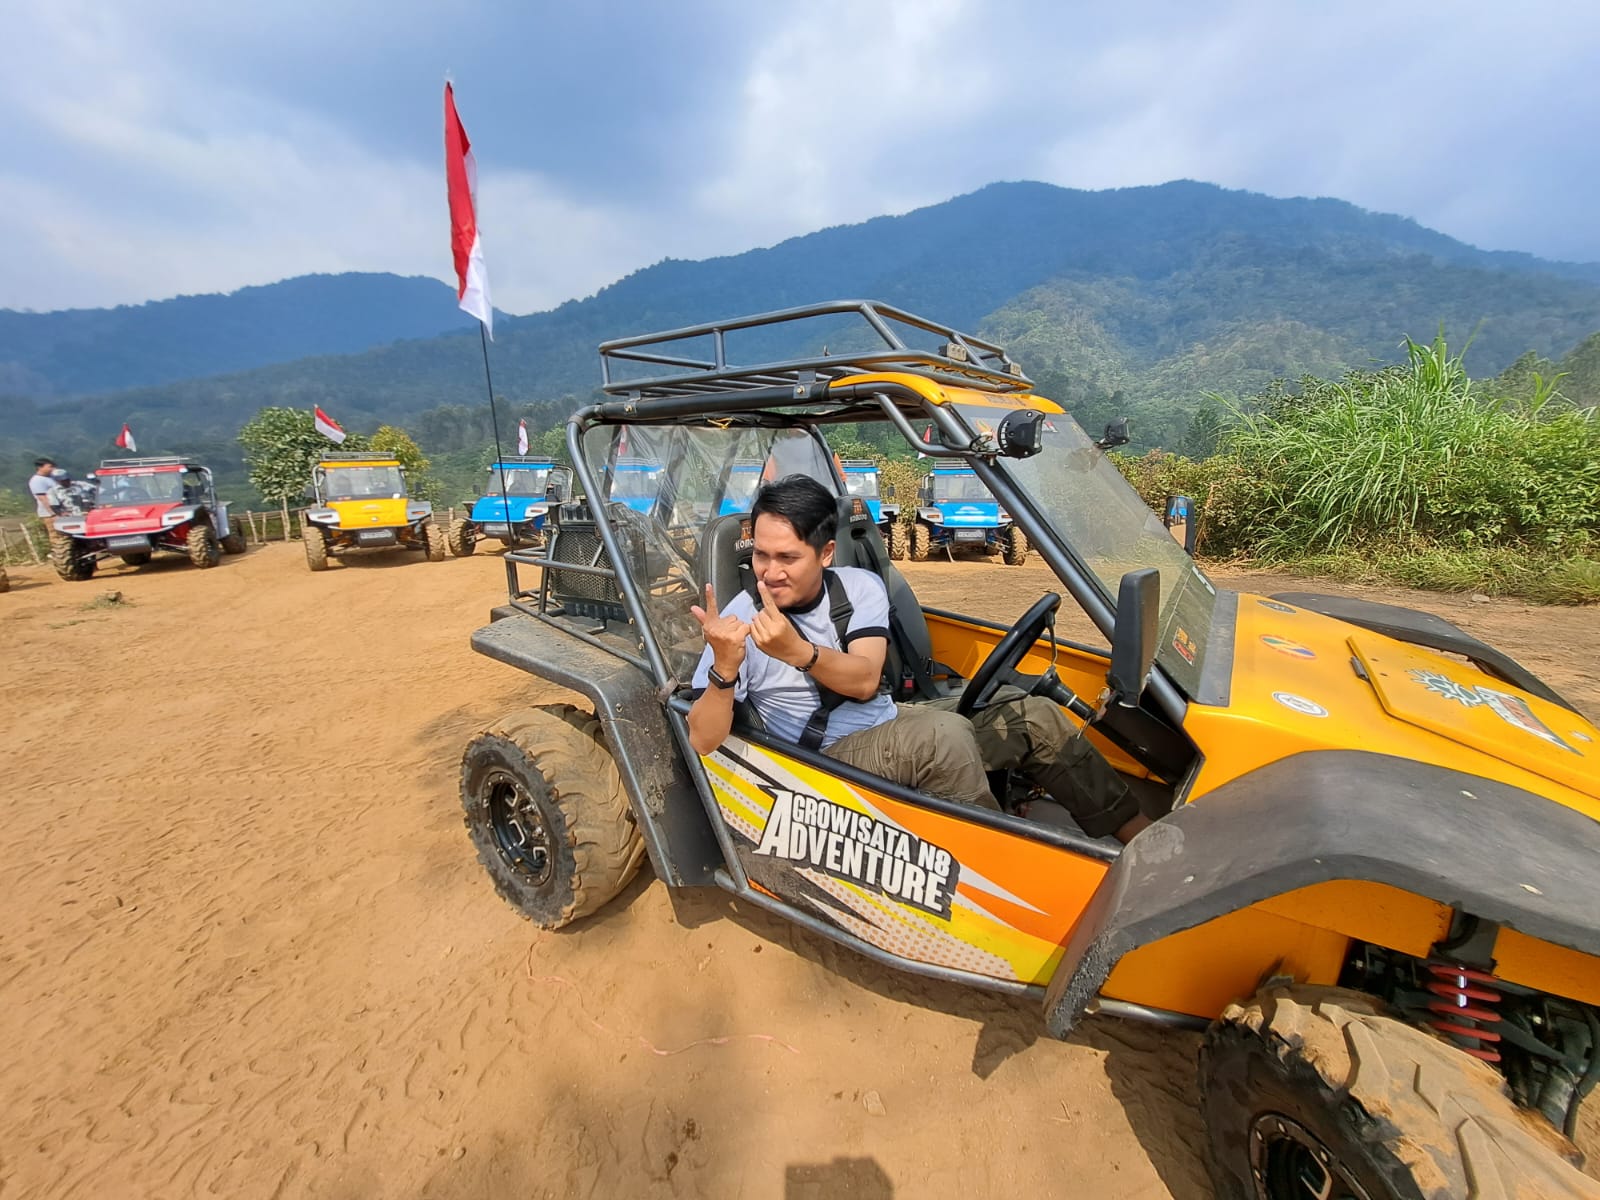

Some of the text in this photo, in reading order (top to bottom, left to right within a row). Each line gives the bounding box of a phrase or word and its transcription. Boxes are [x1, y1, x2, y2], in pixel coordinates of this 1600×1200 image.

[735, 538, 754, 551] KOMO
[753, 788, 947, 912] ADVENTURE
[917, 838, 952, 879] N8
